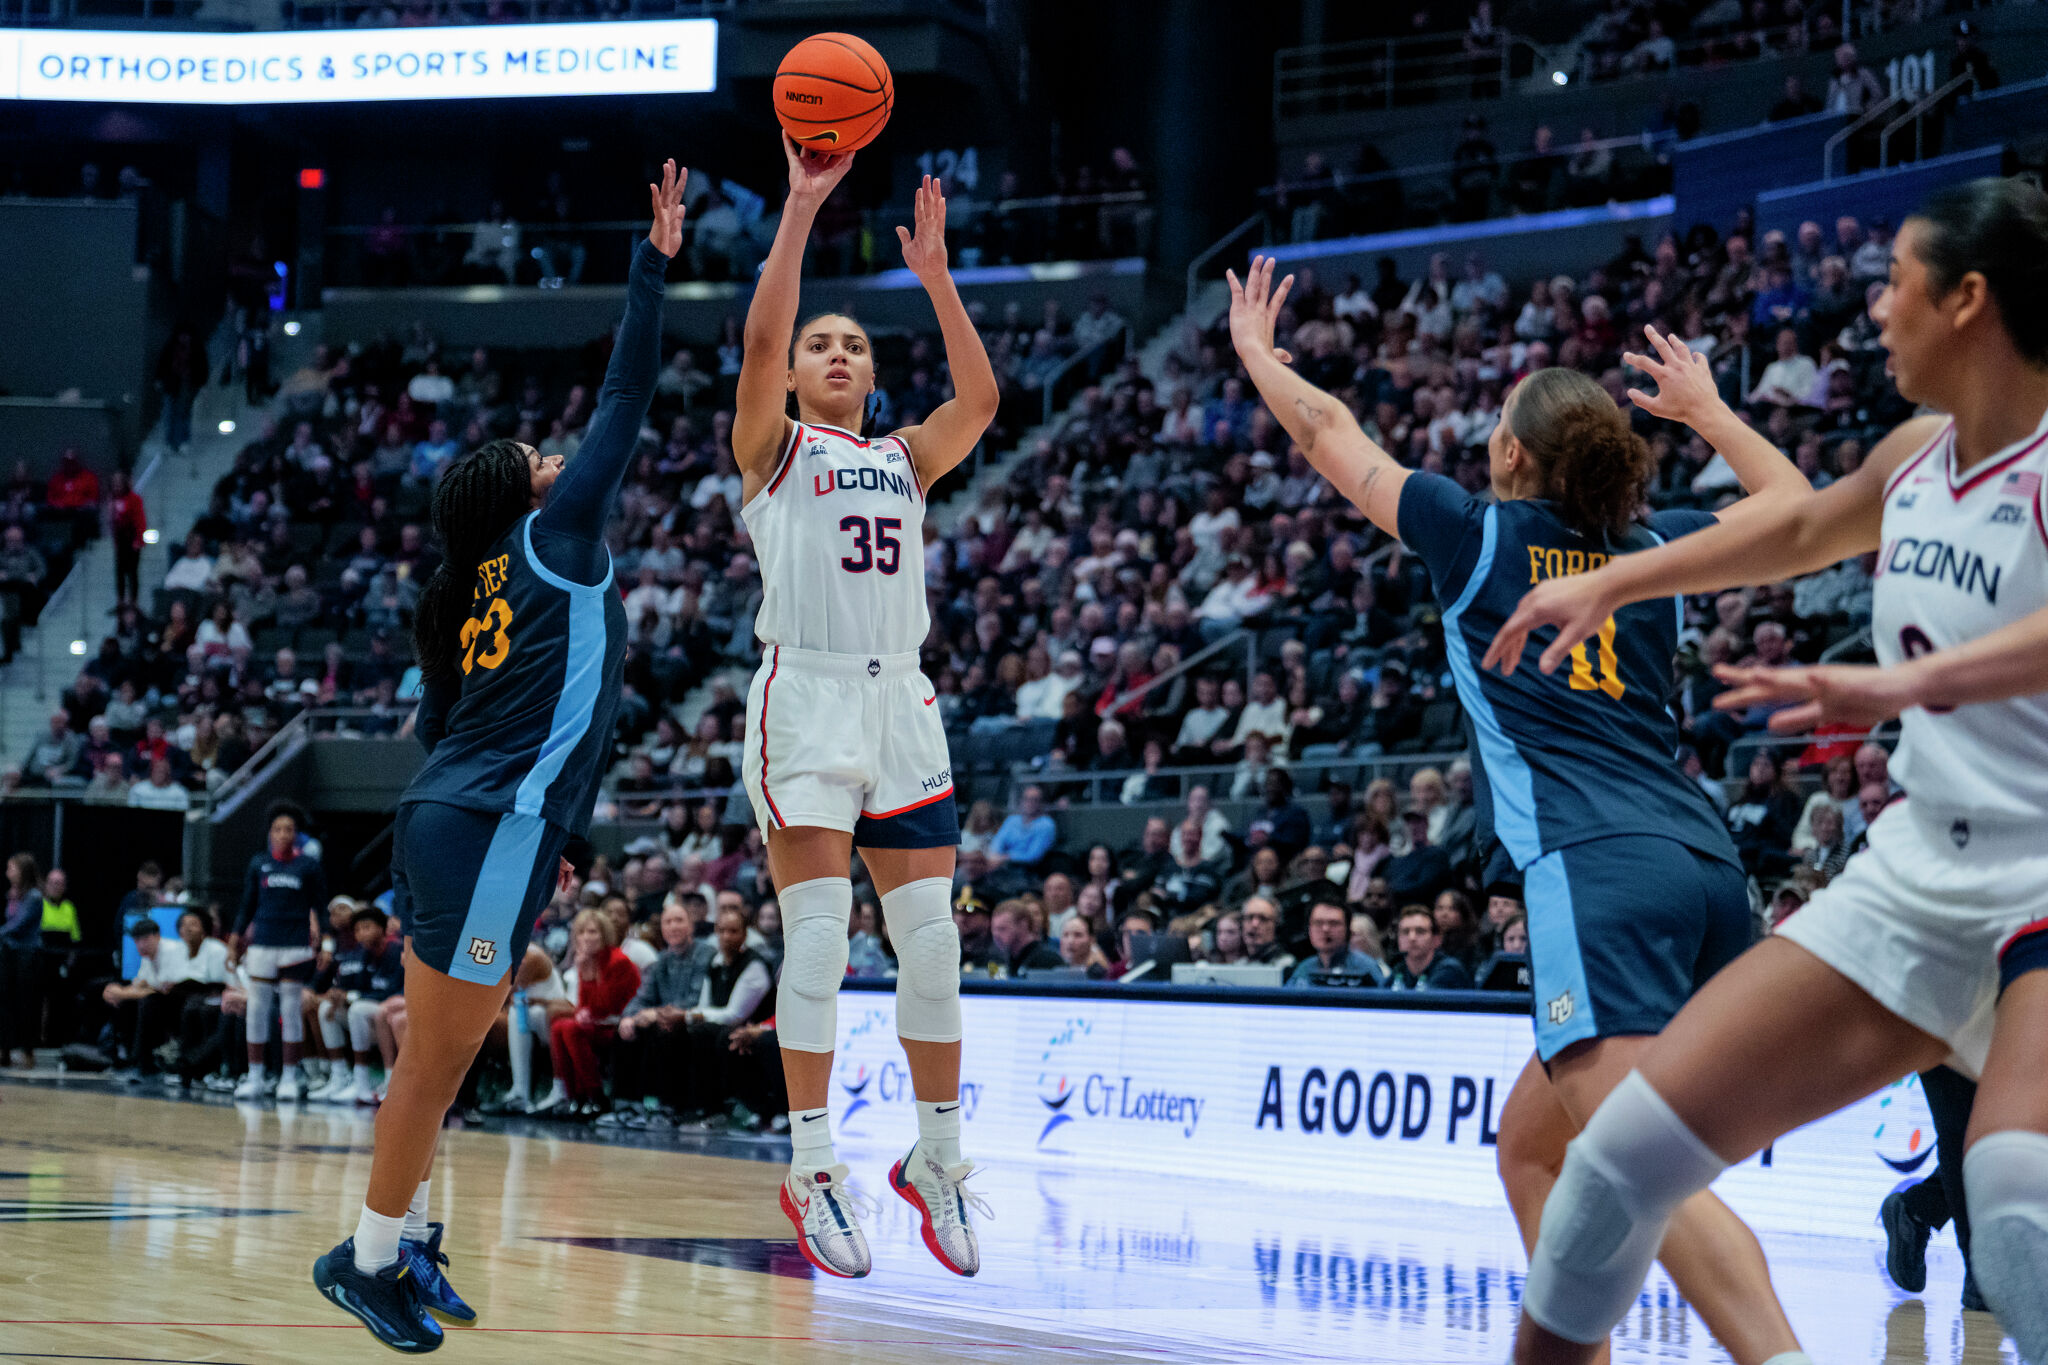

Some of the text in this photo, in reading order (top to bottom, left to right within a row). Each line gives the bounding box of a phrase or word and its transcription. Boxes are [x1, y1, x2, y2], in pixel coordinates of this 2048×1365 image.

[39, 44, 679, 83] ORTHOPEDICS & SPORTS MEDICINE
[1885, 50, 1935, 104] 101
[785, 90, 823, 106] UCONN
[916, 147, 978, 192] 124
[814, 467, 914, 504] UCONN
[839, 514, 902, 576] 35
[1873, 536, 2001, 607] UCONN
[467, 936, 498, 966] MU
[1119, 1076, 1206, 1139] Lottery
[1255, 1065, 1284, 1131] A
[1299, 1066, 1433, 1141] GOOD
